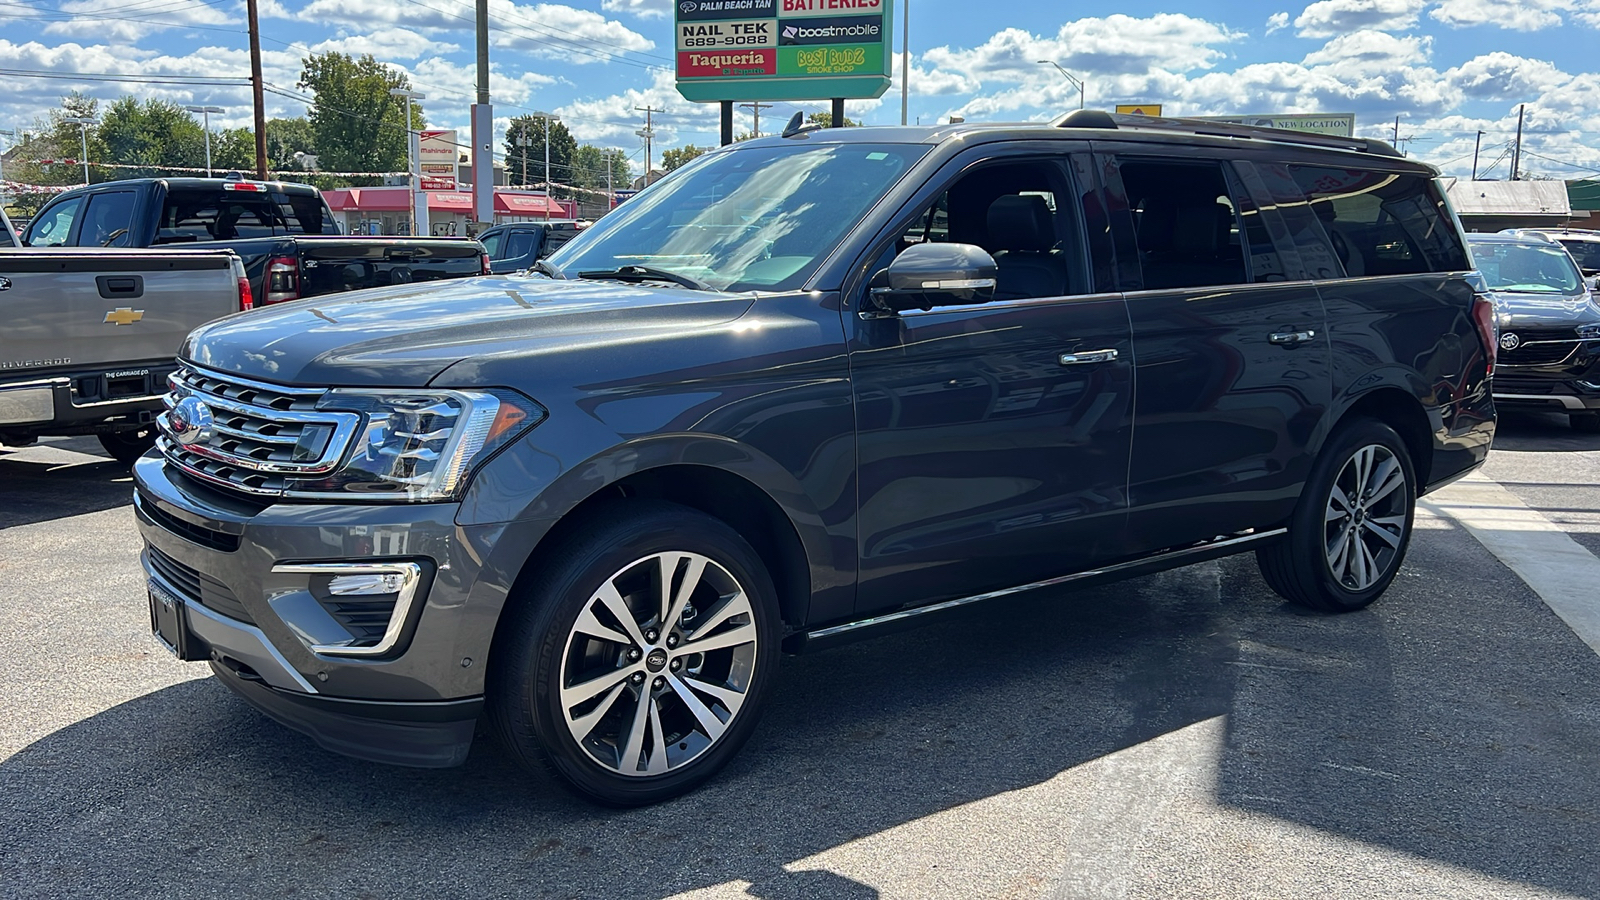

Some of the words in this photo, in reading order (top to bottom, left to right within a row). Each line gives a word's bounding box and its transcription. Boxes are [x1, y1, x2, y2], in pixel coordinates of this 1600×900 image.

[700, 2, 723, 11] PALM
[724, 0, 752, 10] BEACH
[755, 0, 772, 8] TAN
[683, 25, 723, 36] NAIL
[731, 23, 768, 34] TEK
[685, 36, 767, 46] 689-9088
[807, 66, 832, 74] SMOKE
[833, 65, 854, 73] SHOP
[1300, 120, 1347, 128] LOCATION
[0, 358, 71, 369] ILVERADO
